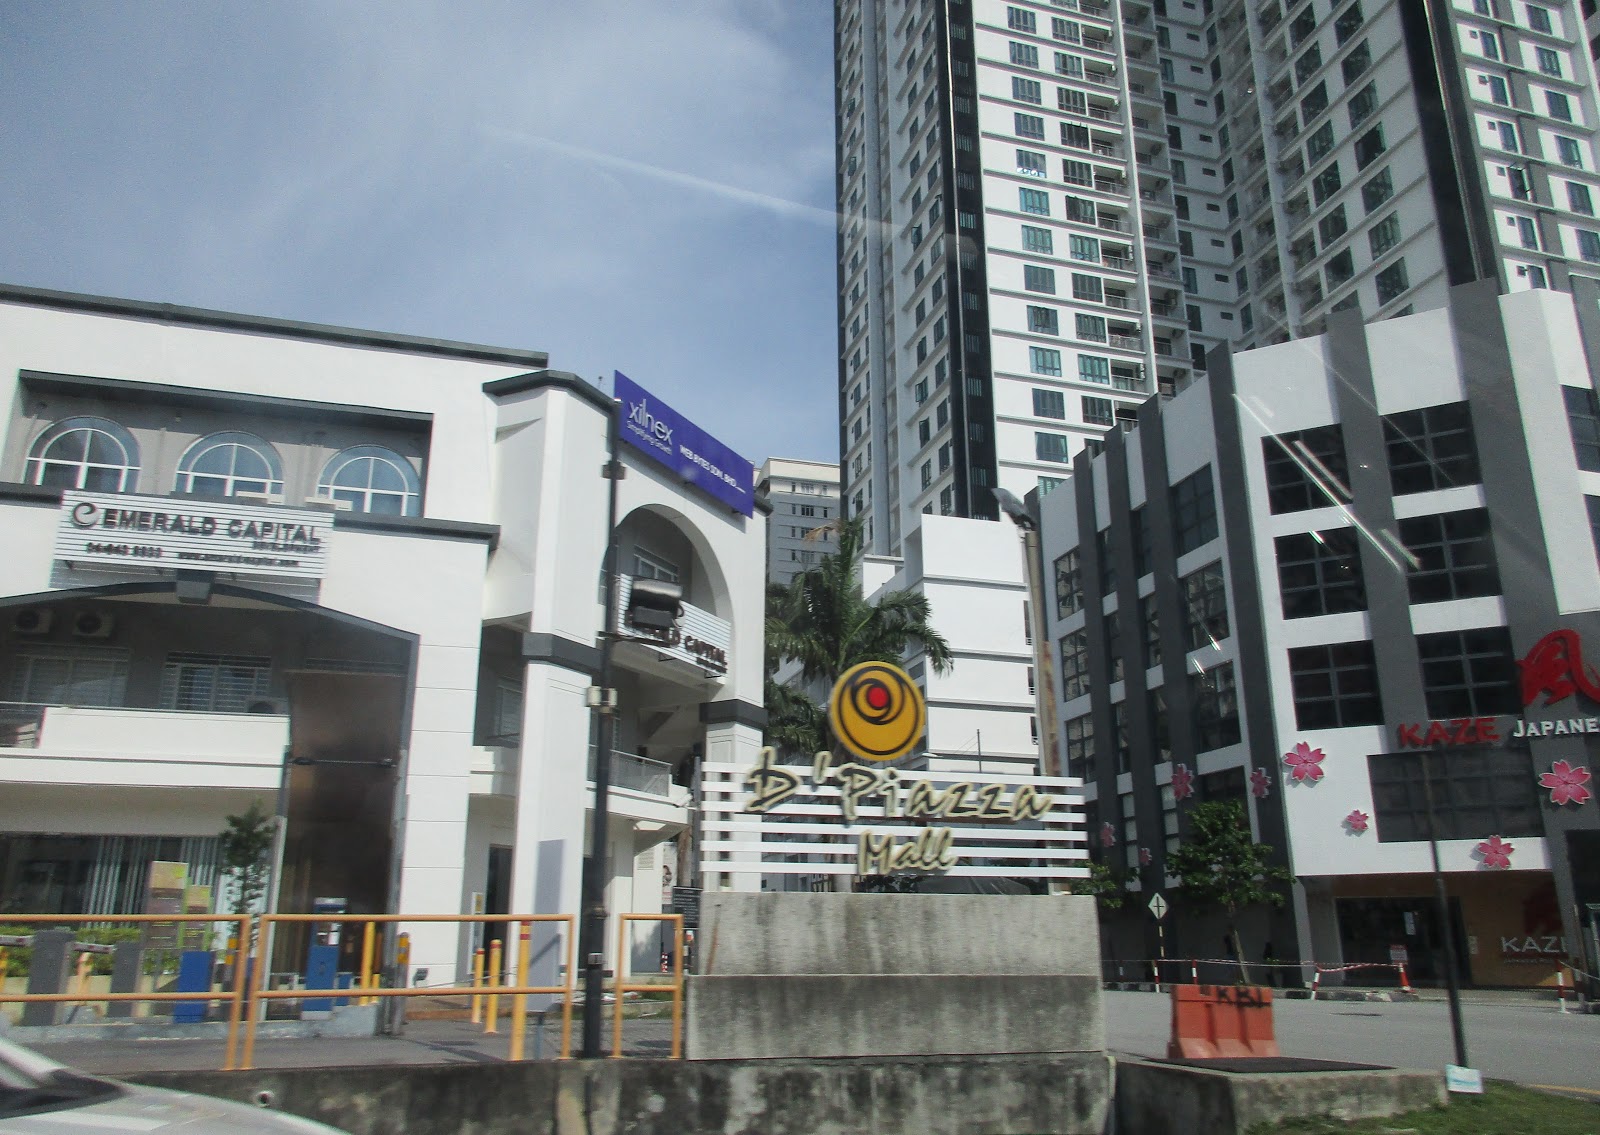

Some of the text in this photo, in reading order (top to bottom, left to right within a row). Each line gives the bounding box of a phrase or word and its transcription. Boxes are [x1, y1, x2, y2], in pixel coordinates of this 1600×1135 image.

[628, 398, 674, 445] xilnex
[101, 508, 217, 536] EMERALD
[227, 519, 322, 544] CAPITAL
[1399, 717, 1600, 747] KAZE JAPANE
[857, 826, 960, 876] Mall
